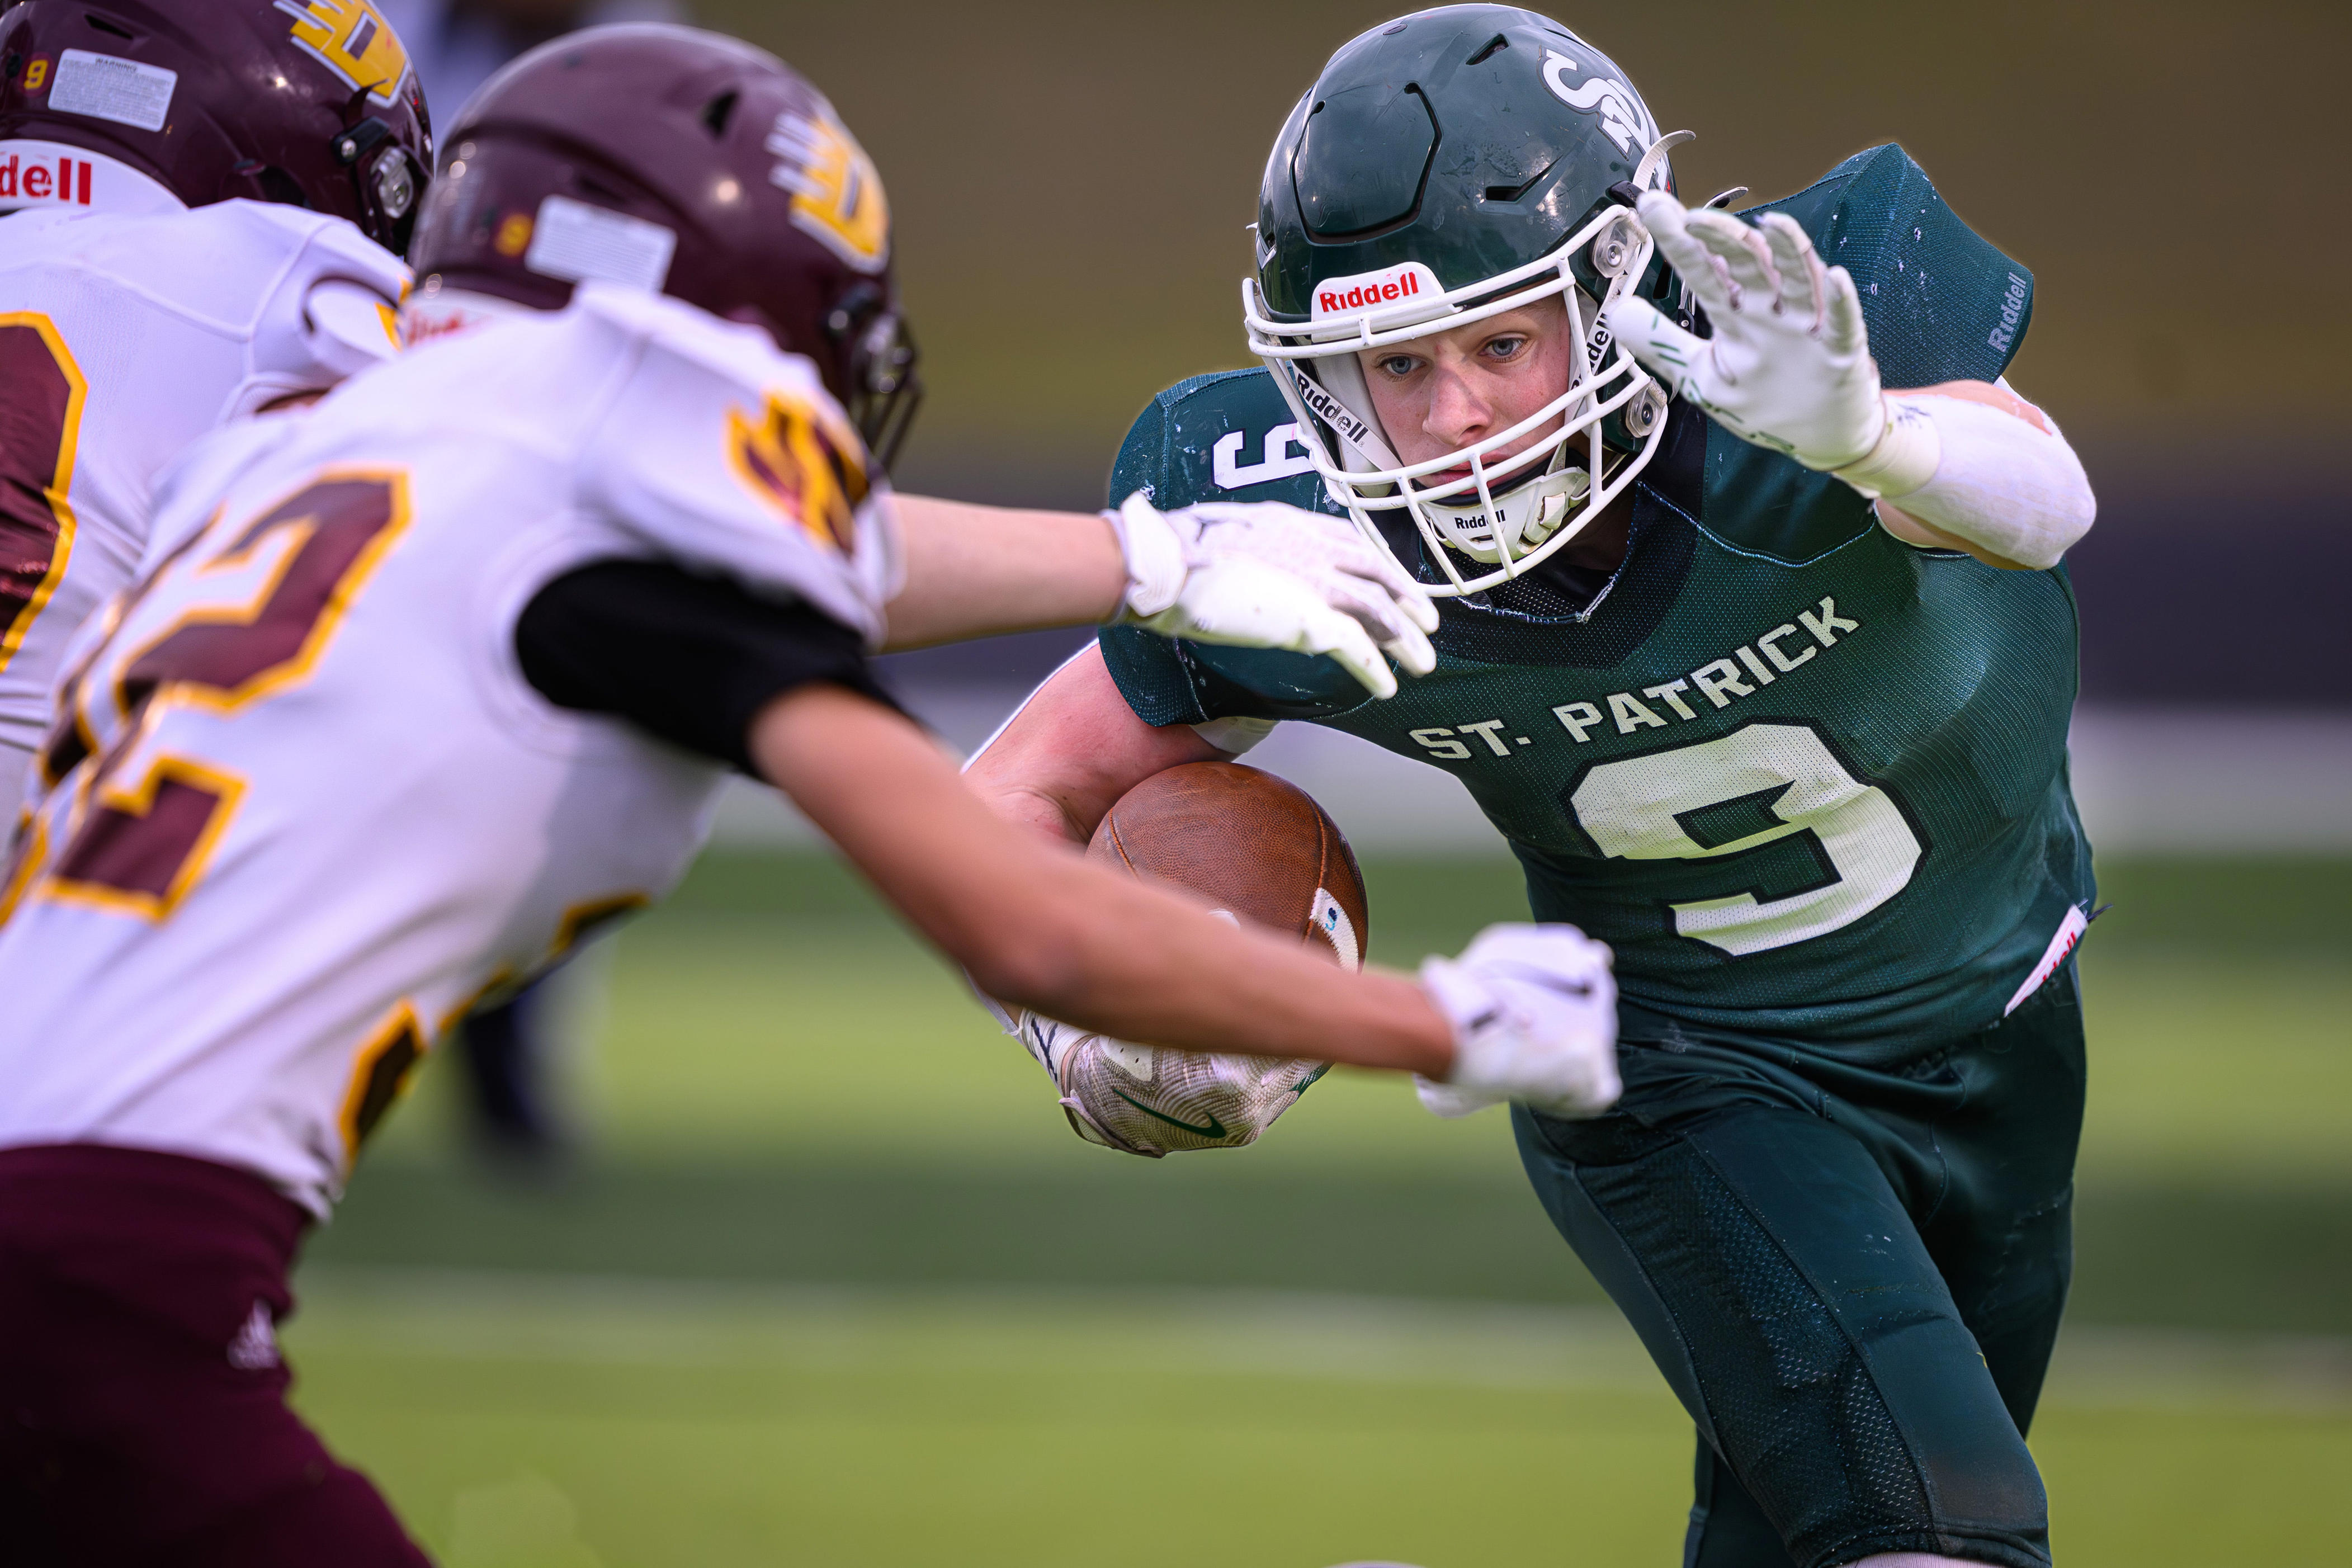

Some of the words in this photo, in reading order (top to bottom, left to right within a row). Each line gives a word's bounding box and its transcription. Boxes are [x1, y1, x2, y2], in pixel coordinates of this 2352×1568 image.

[23, 59, 49, 89] 9
[1319, 271, 1419, 313] Riddell
[1987, 272, 2027, 352] Riddell
[1297, 373, 1368, 443] Riddell
[1454, 509, 1506, 529] Riddll
[1409, 719, 1534, 759] ST.
[1552, 596, 1860, 743] PATRICK
[1569, 722, 1923, 957] 9
